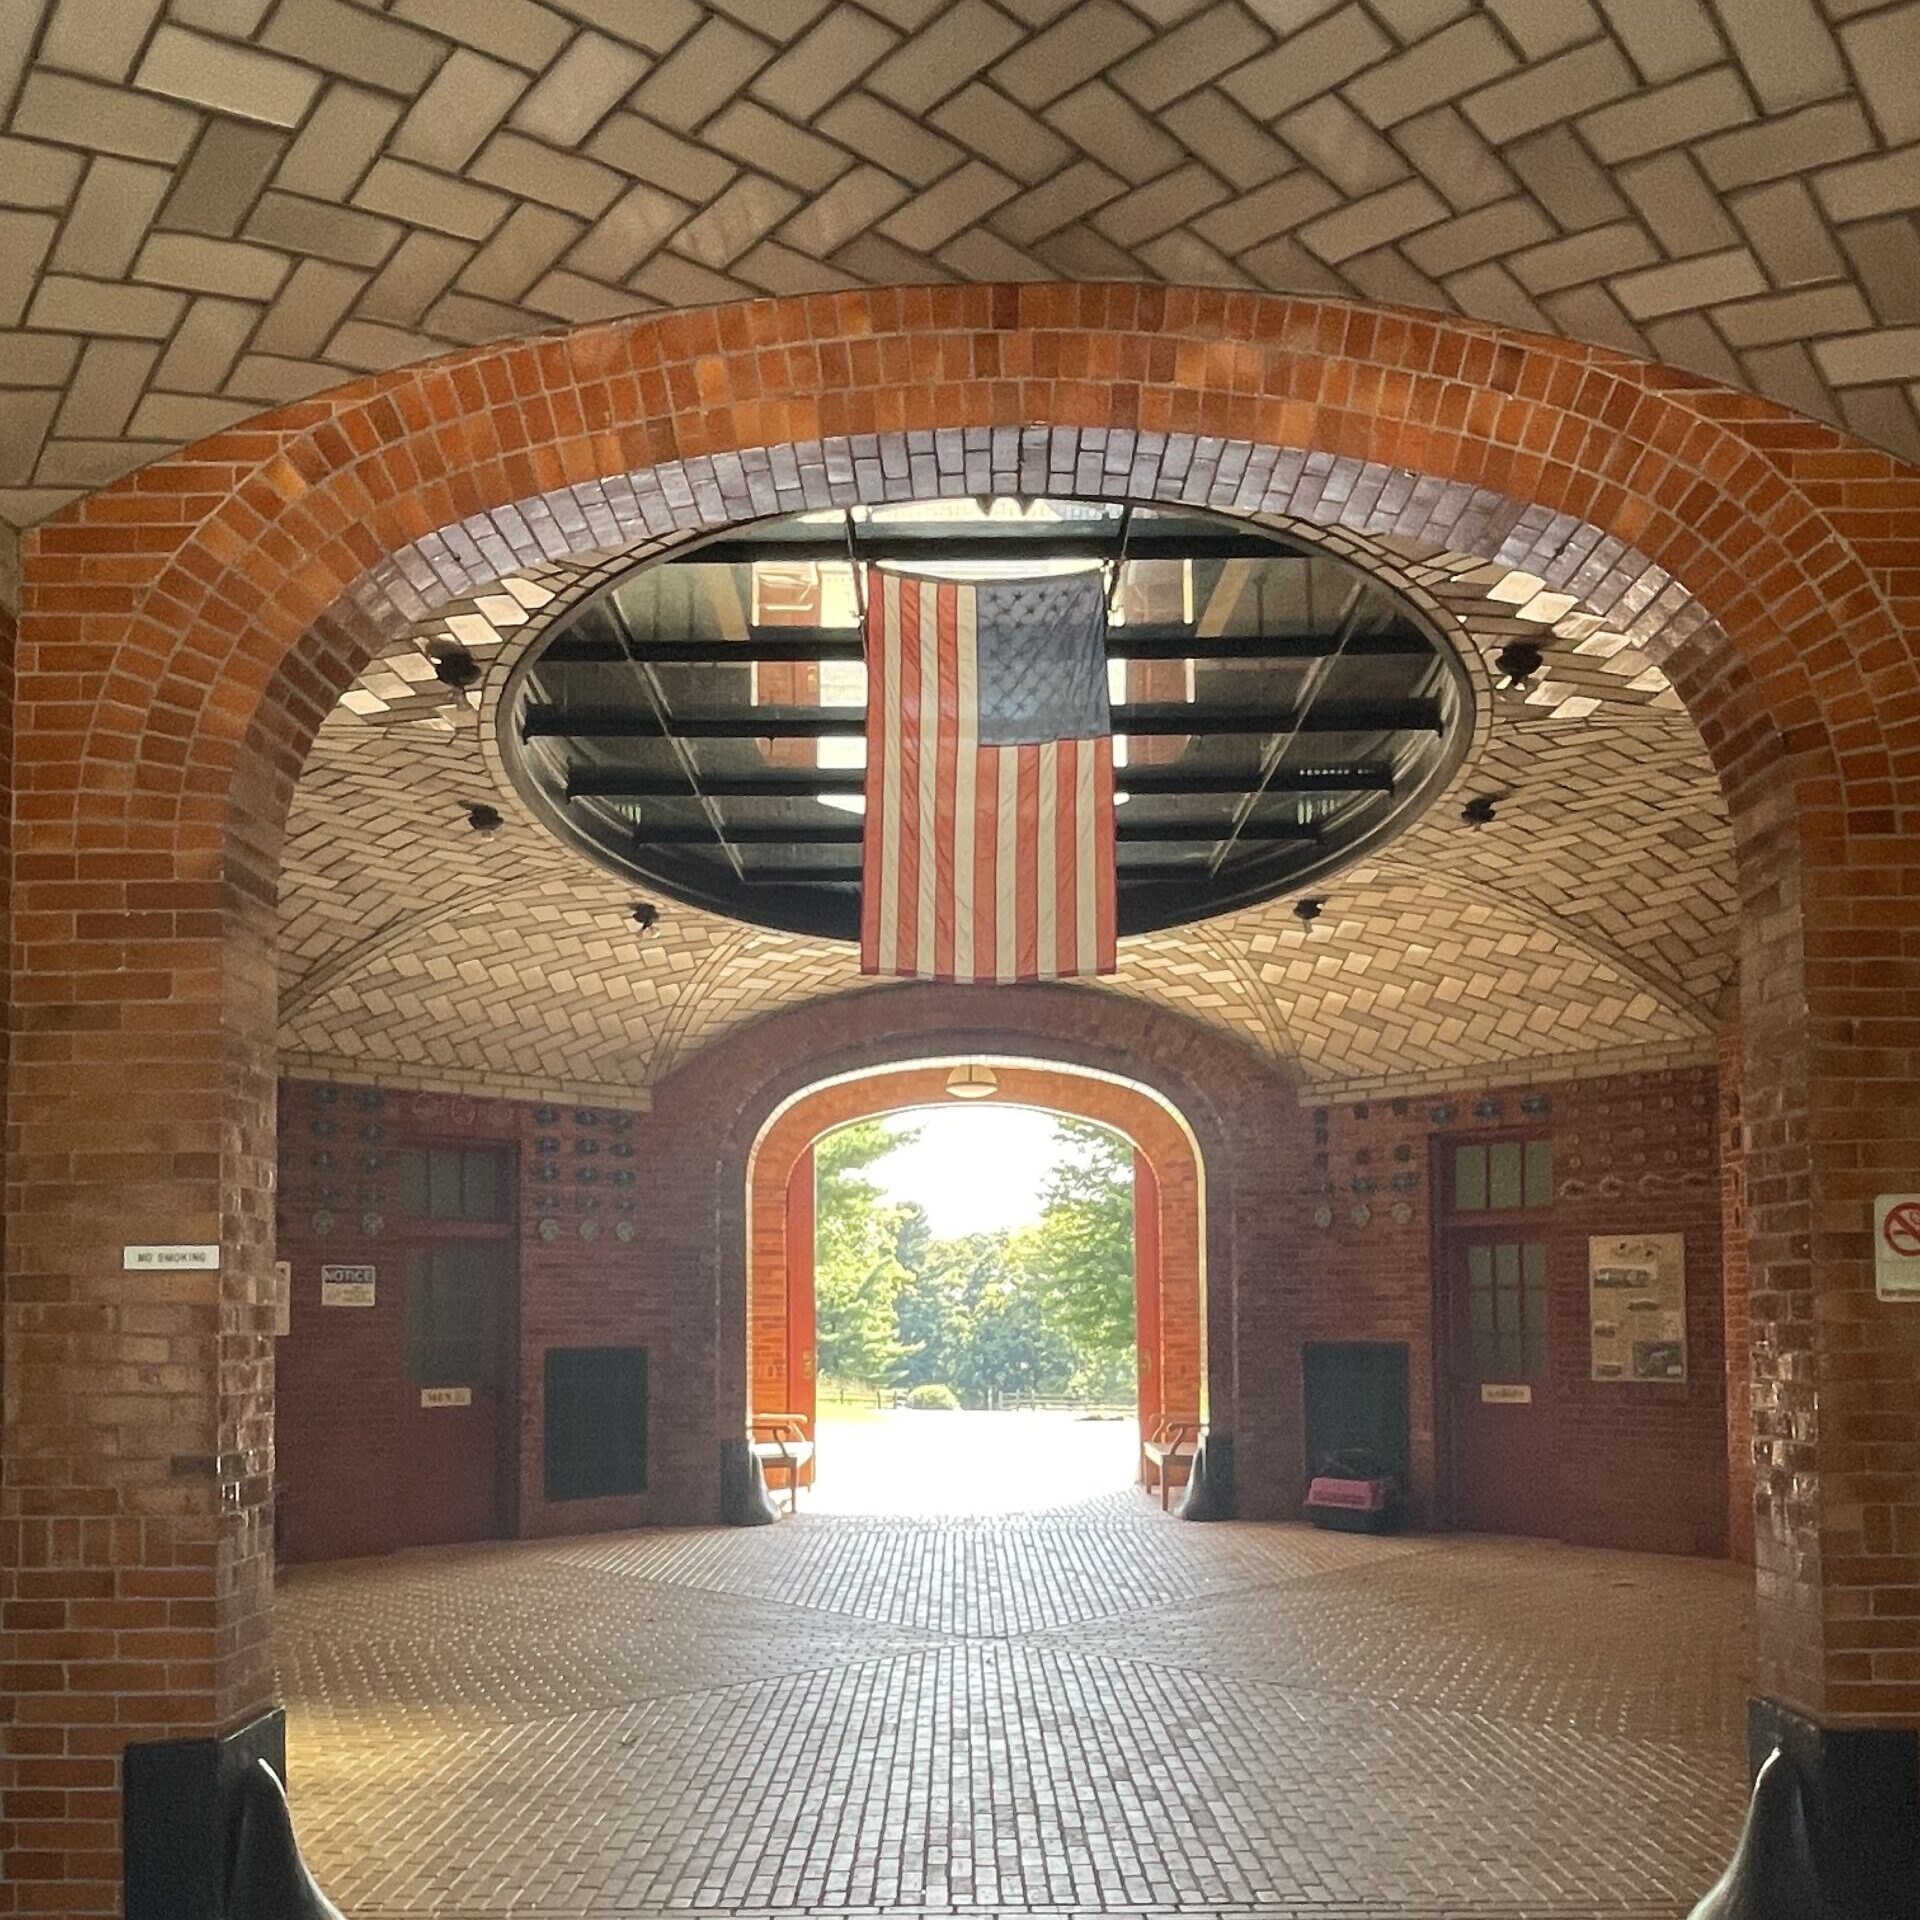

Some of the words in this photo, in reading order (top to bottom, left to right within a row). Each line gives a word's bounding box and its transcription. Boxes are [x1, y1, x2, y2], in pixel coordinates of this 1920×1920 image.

[138, 1253, 152, 1262] NO
[158, 1252, 206, 1262] SMOKING
[323, 1269, 373, 1281] NOTICE
